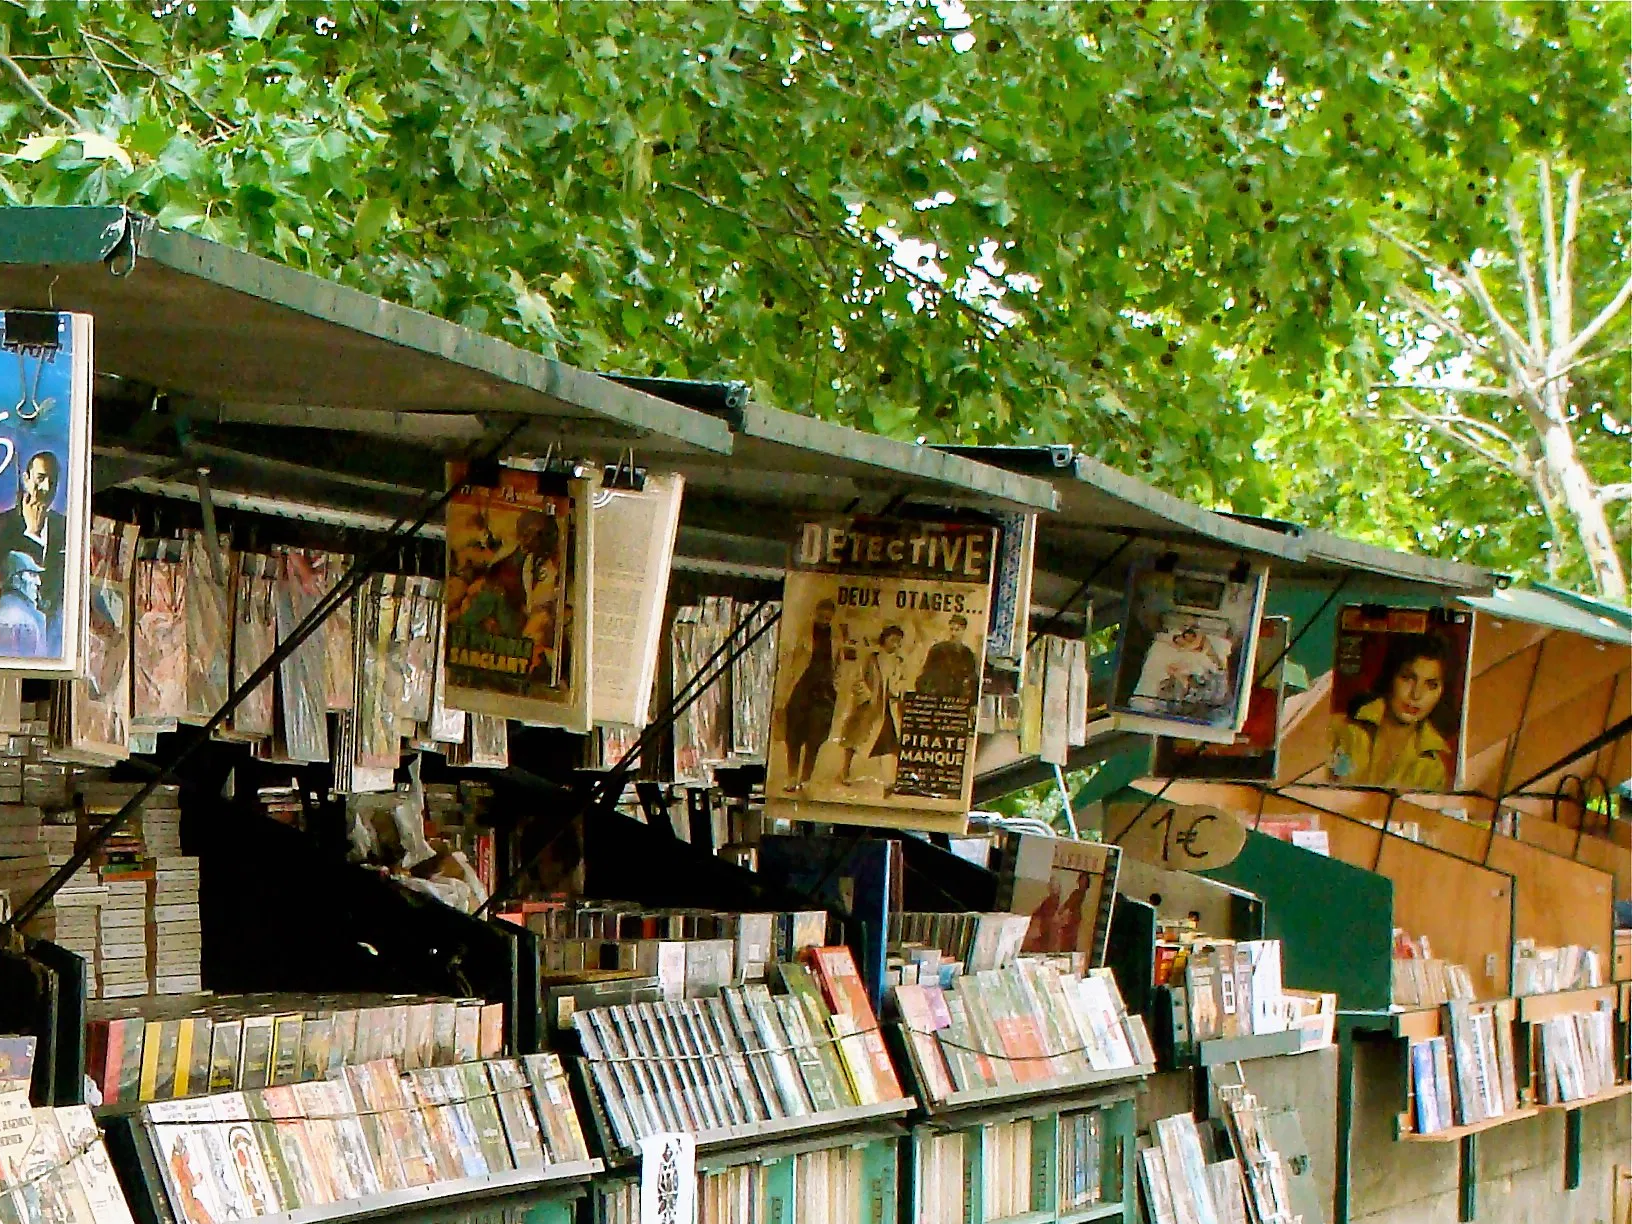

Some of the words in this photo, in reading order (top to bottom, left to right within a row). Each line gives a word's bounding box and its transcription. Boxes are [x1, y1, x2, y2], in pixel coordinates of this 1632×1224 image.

[801, 522, 986, 577] DETECTIVE
[837, 585, 881, 608] DEUX
[895, 590, 984, 616] OTAGES...
[902, 733, 966, 751] PIRATE
[1151, 808, 1218, 862] 1€
